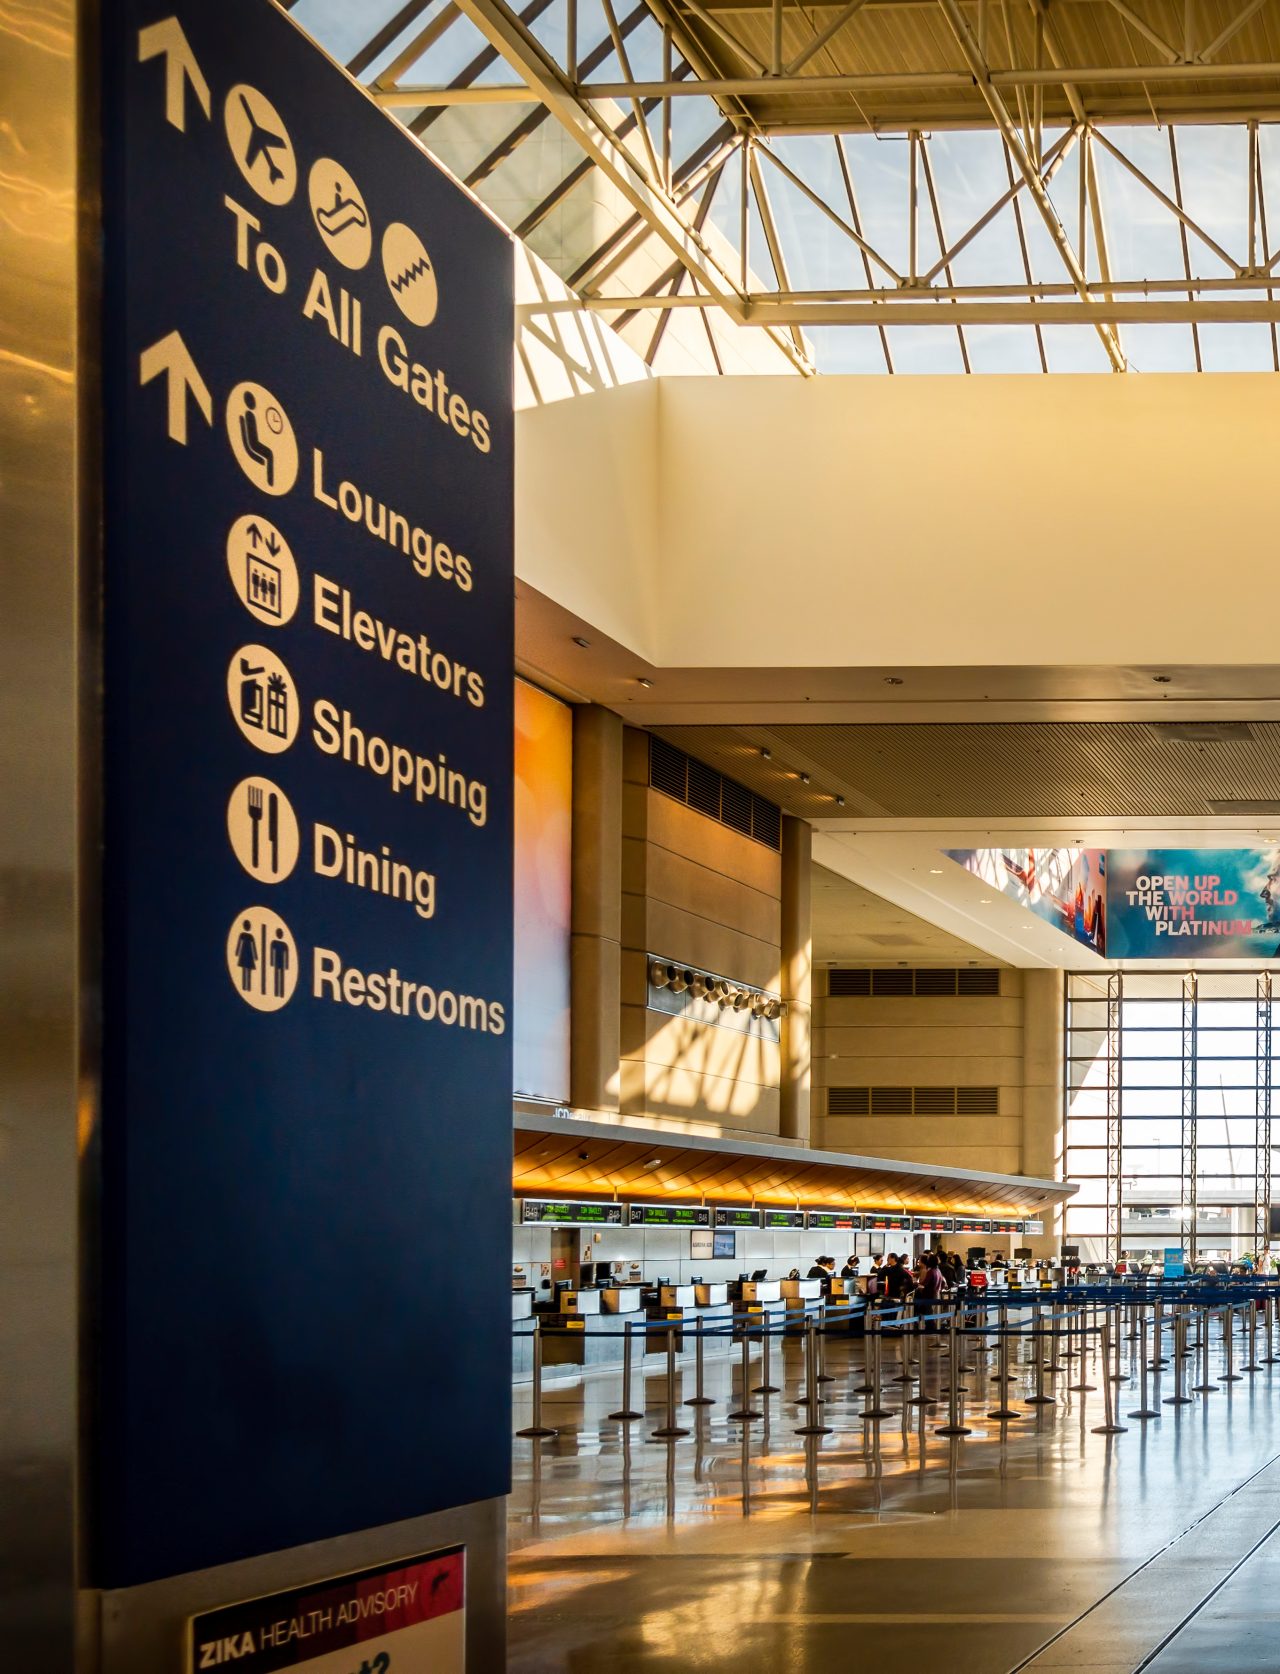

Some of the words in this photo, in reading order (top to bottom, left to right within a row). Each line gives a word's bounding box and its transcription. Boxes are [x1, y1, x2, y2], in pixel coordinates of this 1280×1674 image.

[224, 195, 287, 295] To
[302, 269, 362, 357] All
[377, 325, 491, 454] Gates
[313, 448, 473, 592] Lounges
[313, 574, 484, 708] Elevators
[312, 700, 487, 827] Shopping
[314, 822, 435, 919] Dining
[1125, 891, 1164, 906] THE
[1168, 890, 1239, 906] WORLD
[1135, 875, 1189, 891] OPEN
[1194, 875, 1221, 891] UP
[1145, 905, 1195, 921] WITH
[1155, 920, 1253, 936] PLATINUM
[313, 947, 505, 1035] Restrooms
[631, 1211, 642, 1220] B47
[199, 1630, 257, 1669] ZIKA
[260, 1607, 333, 1650] HEALTH
[335, 1581, 419, 1628] ADVISORY
